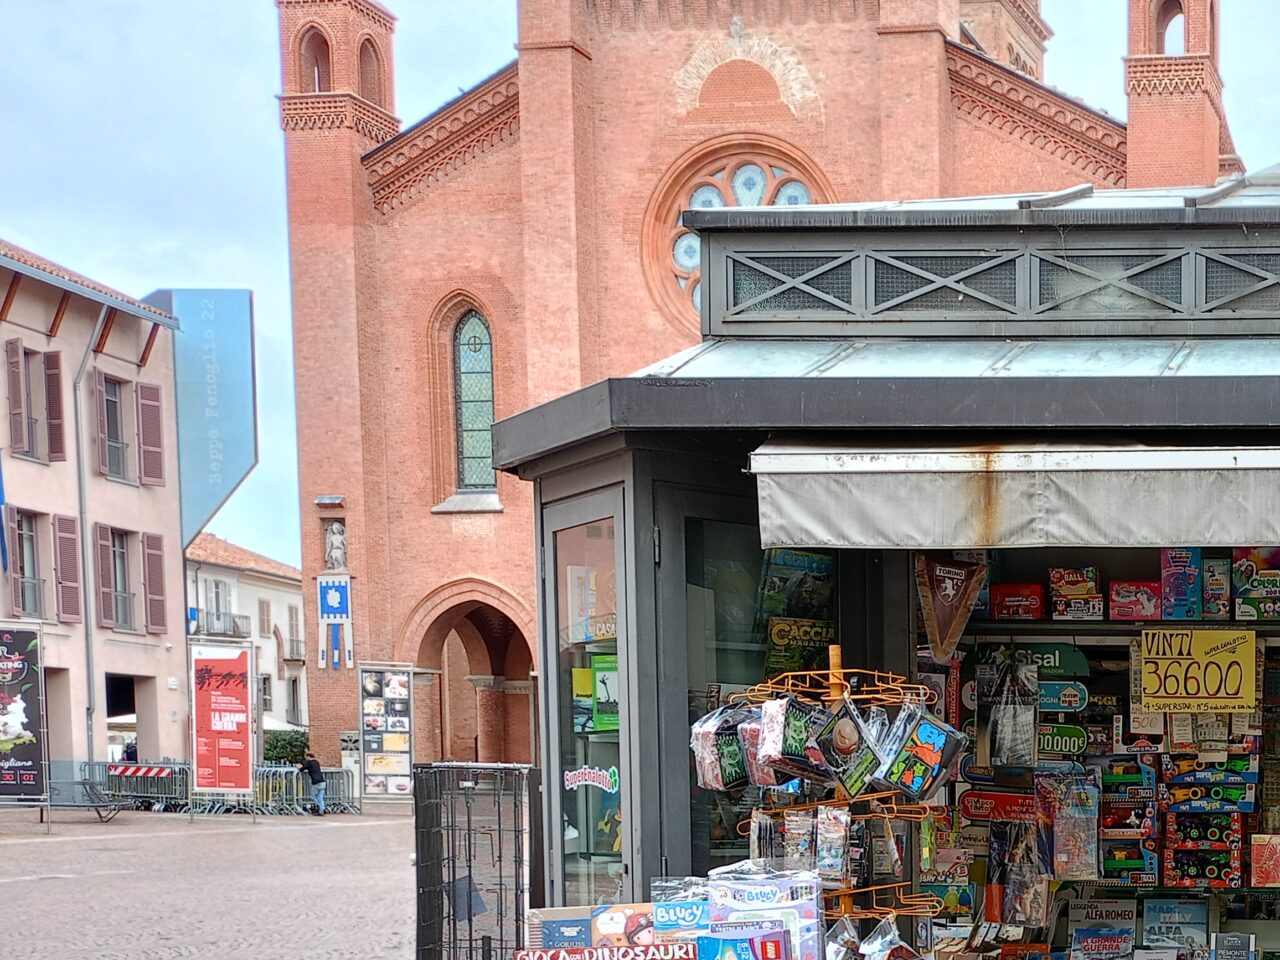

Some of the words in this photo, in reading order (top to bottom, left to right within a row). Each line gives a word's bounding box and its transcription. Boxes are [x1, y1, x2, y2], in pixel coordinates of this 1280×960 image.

[939, 568, 964, 577] TORINO
[771, 623, 835, 646] CACCIA
[1015, 649, 1060, 667] Sisal
[1143, 660, 1243, 696] 36.600
[565, 767, 612, 790] SuperEnalotto
[747, 891, 778, 901] BLUEY
[656, 905, 703, 925] BLUEY
[1085, 911, 1104, 920] ALFA
[1105, 910, 1134, 920] ROMEO
[1149, 926, 1182, 935] ALFA
[1090, 936, 1129, 944] GRANDE
